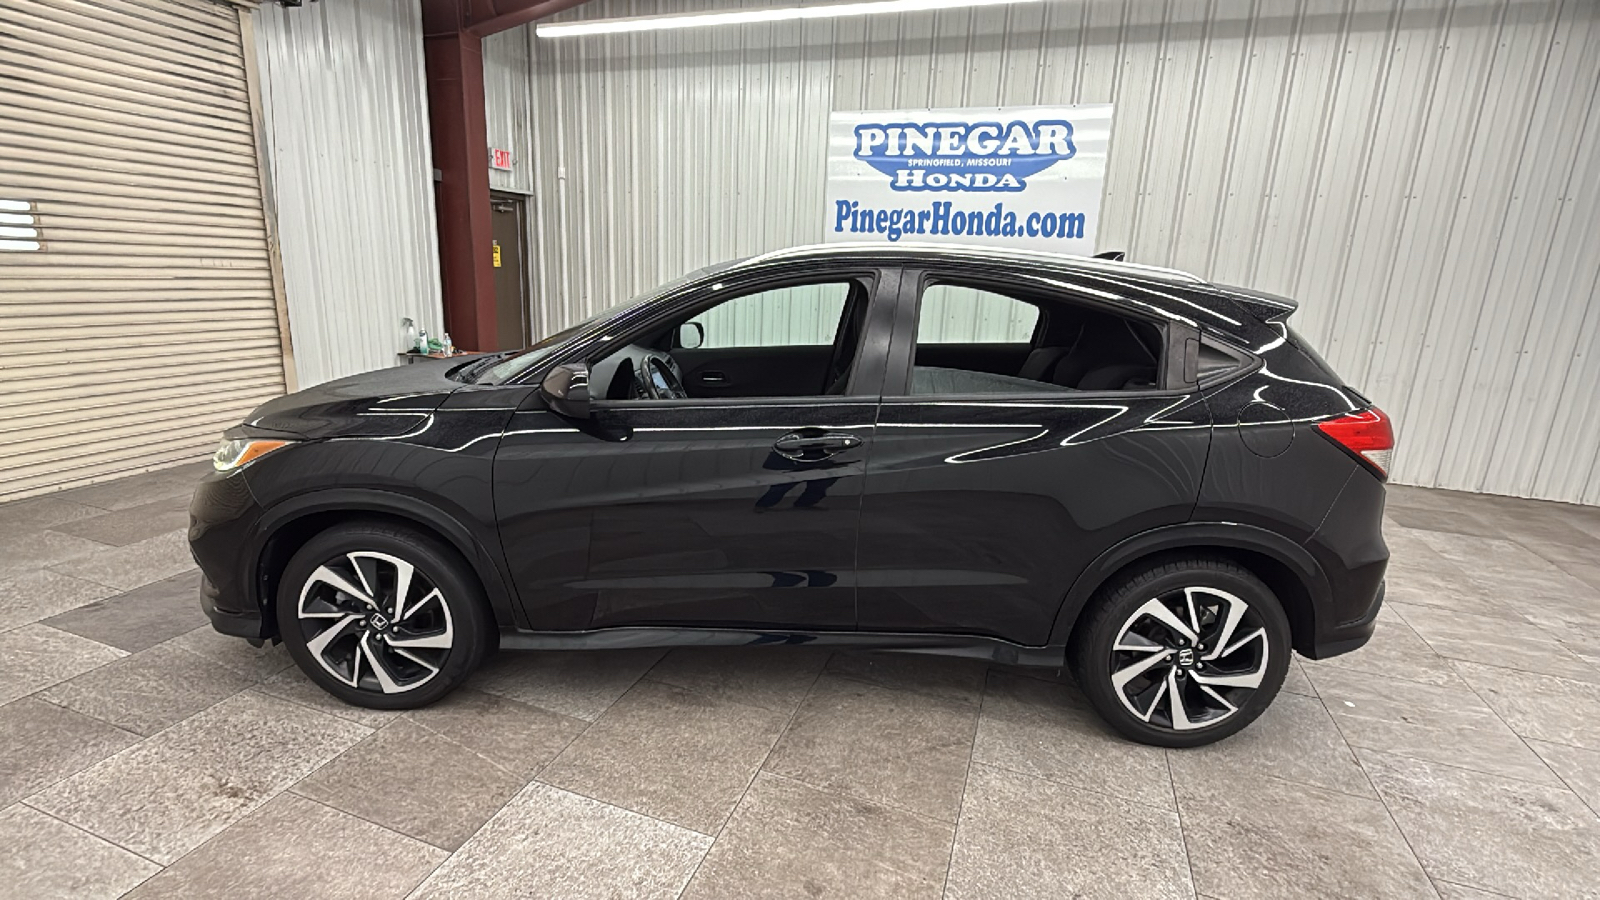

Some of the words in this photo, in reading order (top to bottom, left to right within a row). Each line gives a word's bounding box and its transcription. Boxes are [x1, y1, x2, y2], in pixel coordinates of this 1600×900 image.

[858, 123, 1071, 156] PINEGAR
[494, 148, 511, 168] EXIT
[907, 158, 964, 168] SPRINGFIELD,
[966, 157, 1012, 167] MISSOURI
[894, 169, 1022, 188] HONDA
[834, 199, 1086, 242] PinegarHonda.com
